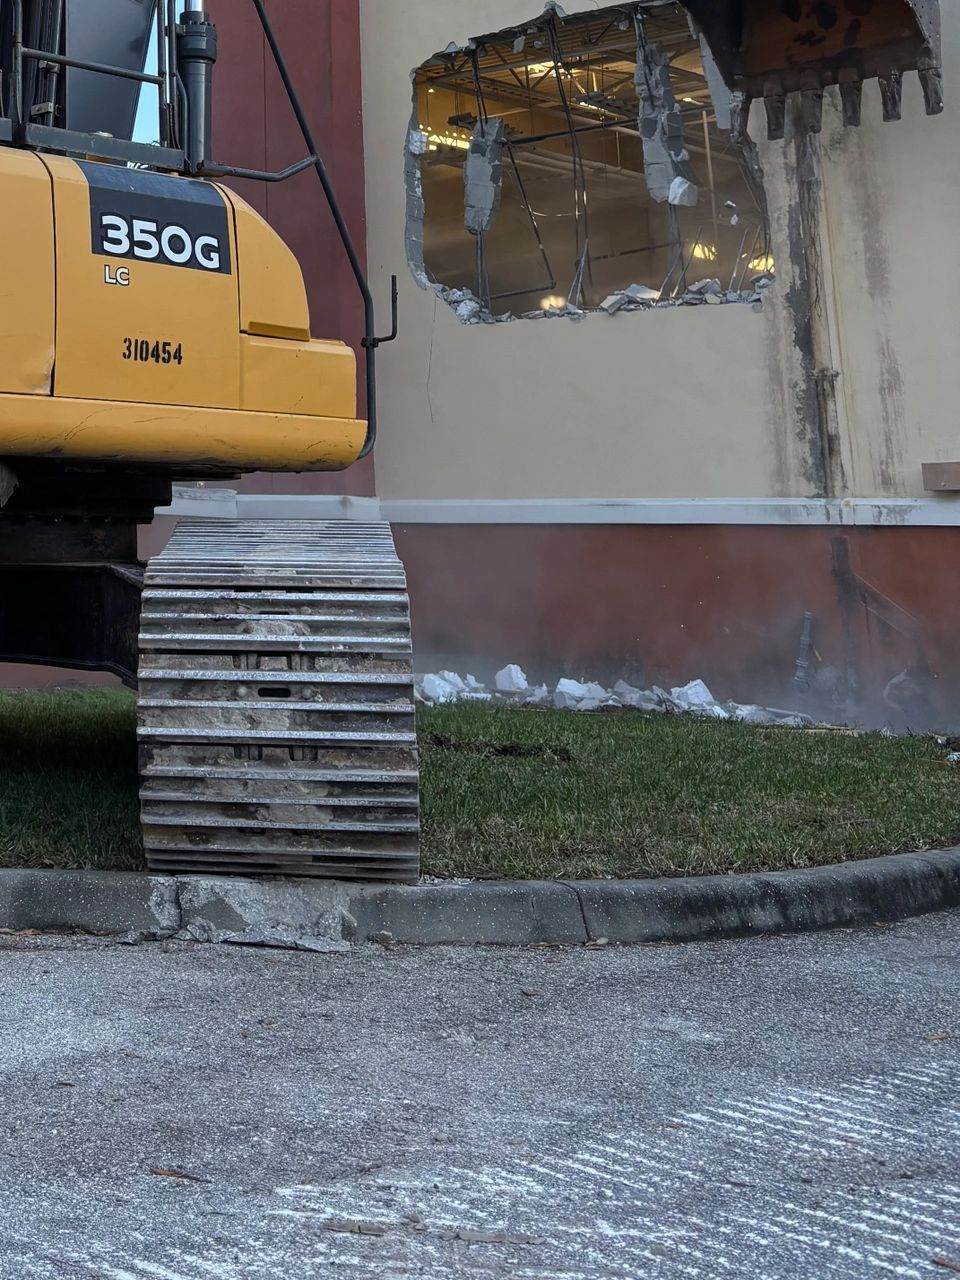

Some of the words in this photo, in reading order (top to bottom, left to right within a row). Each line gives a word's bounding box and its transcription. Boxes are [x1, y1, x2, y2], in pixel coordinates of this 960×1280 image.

[101, 215, 220, 269] 350G
[104, 265, 130, 285] LC
[122, 337, 183, 366] 310454
